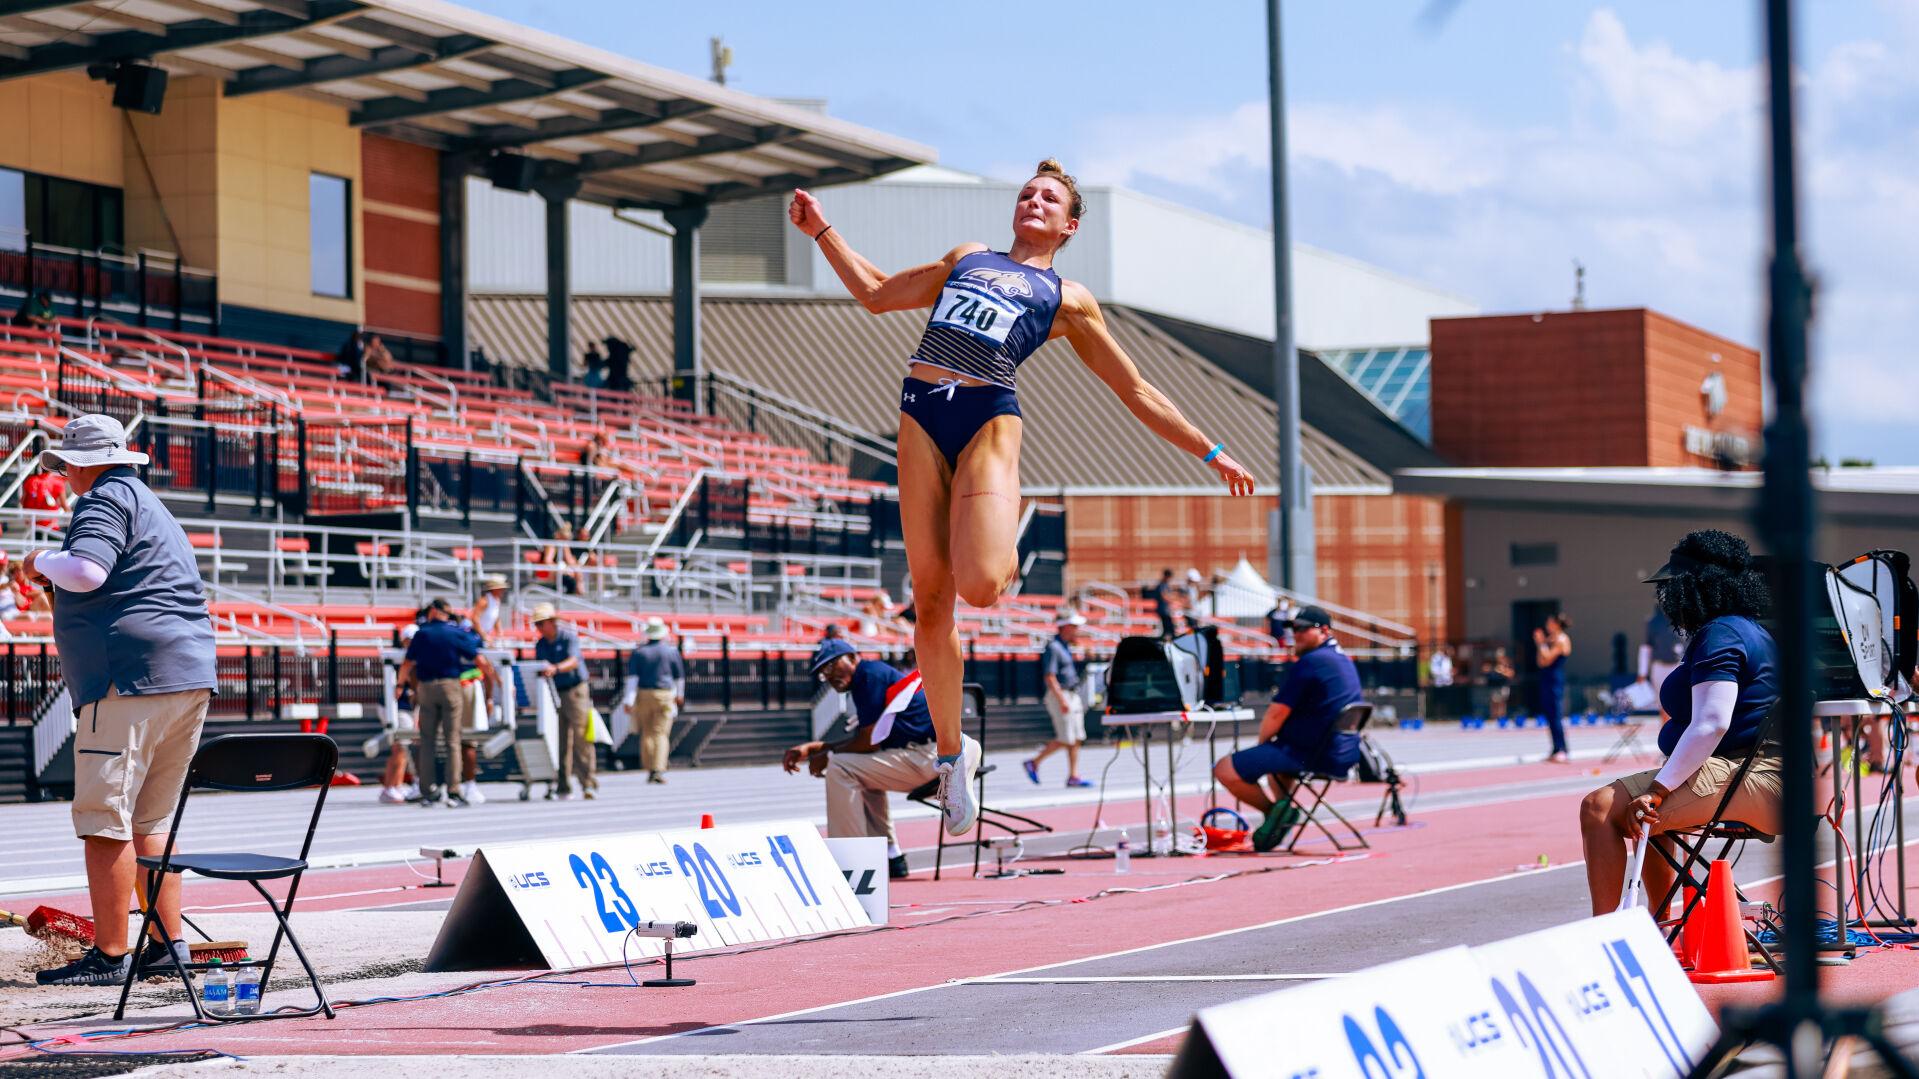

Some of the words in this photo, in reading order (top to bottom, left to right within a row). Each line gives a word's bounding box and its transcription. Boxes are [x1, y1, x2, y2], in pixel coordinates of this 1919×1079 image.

[945, 294, 999, 331] 740
[514, 871, 551, 888] UCS
[568, 851, 641, 933] 23
[640, 861, 673, 877] UCS
[672, 842, 742, 919] 20
[734, 851, 762, 866] UCS
[766, 834, 823, 907] 17
